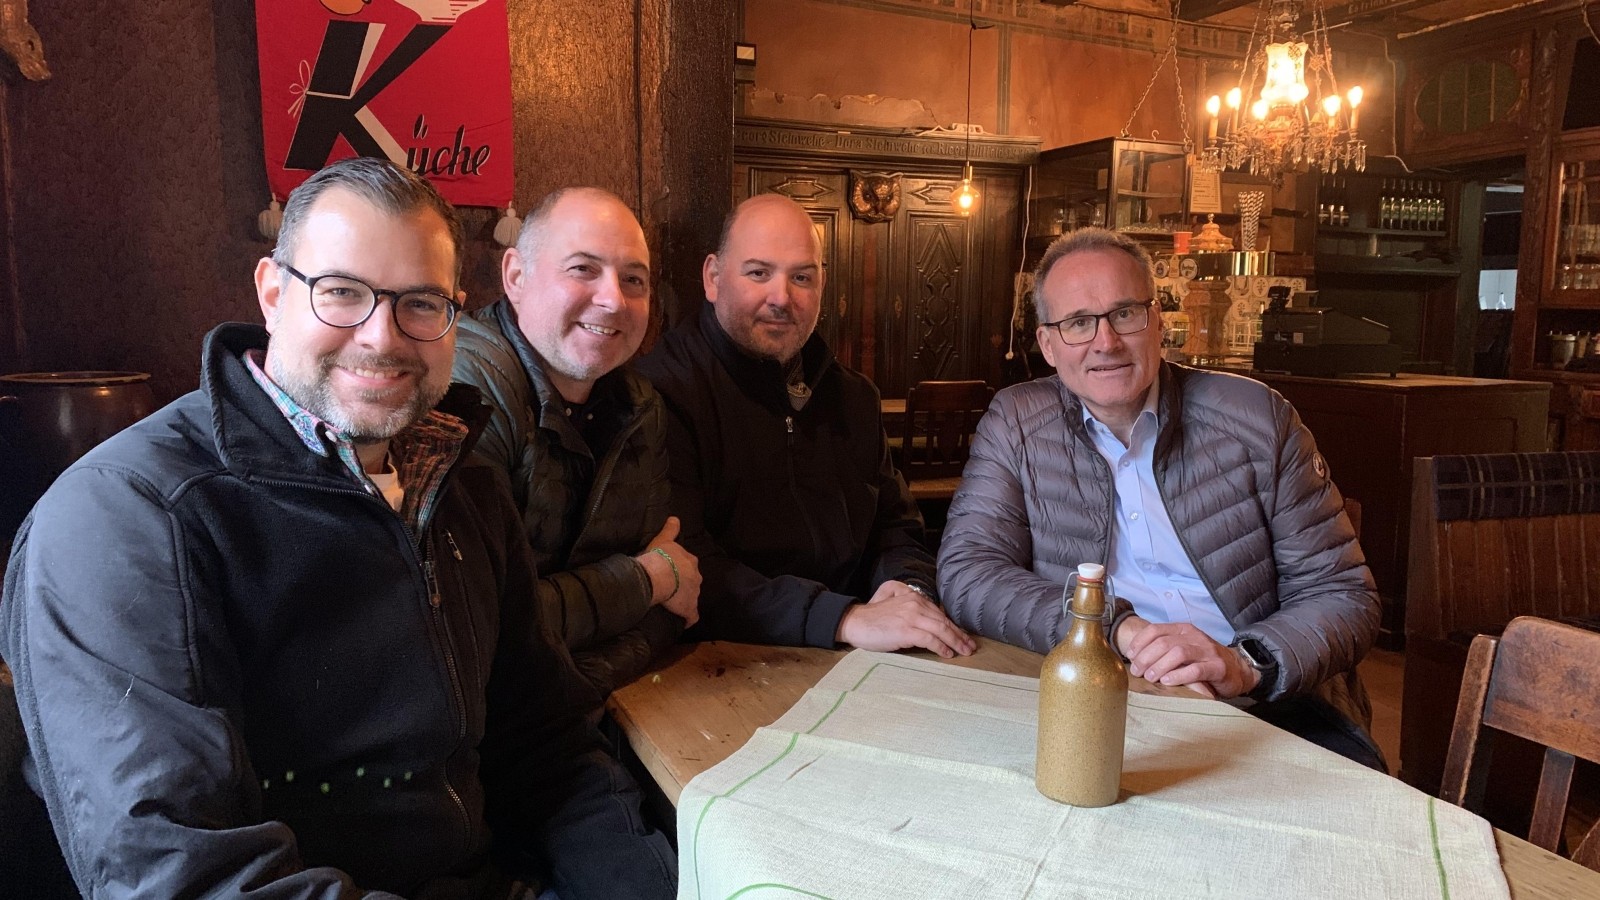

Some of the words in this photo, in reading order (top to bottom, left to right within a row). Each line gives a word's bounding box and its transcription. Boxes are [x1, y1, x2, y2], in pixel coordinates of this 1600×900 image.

[283, 19, 491, 176] Küche
[770, 130, 826, 147] Steinwehe
[836, 135, 863, 149] Dora
[867, 137, 920, 153] Steinwehe
